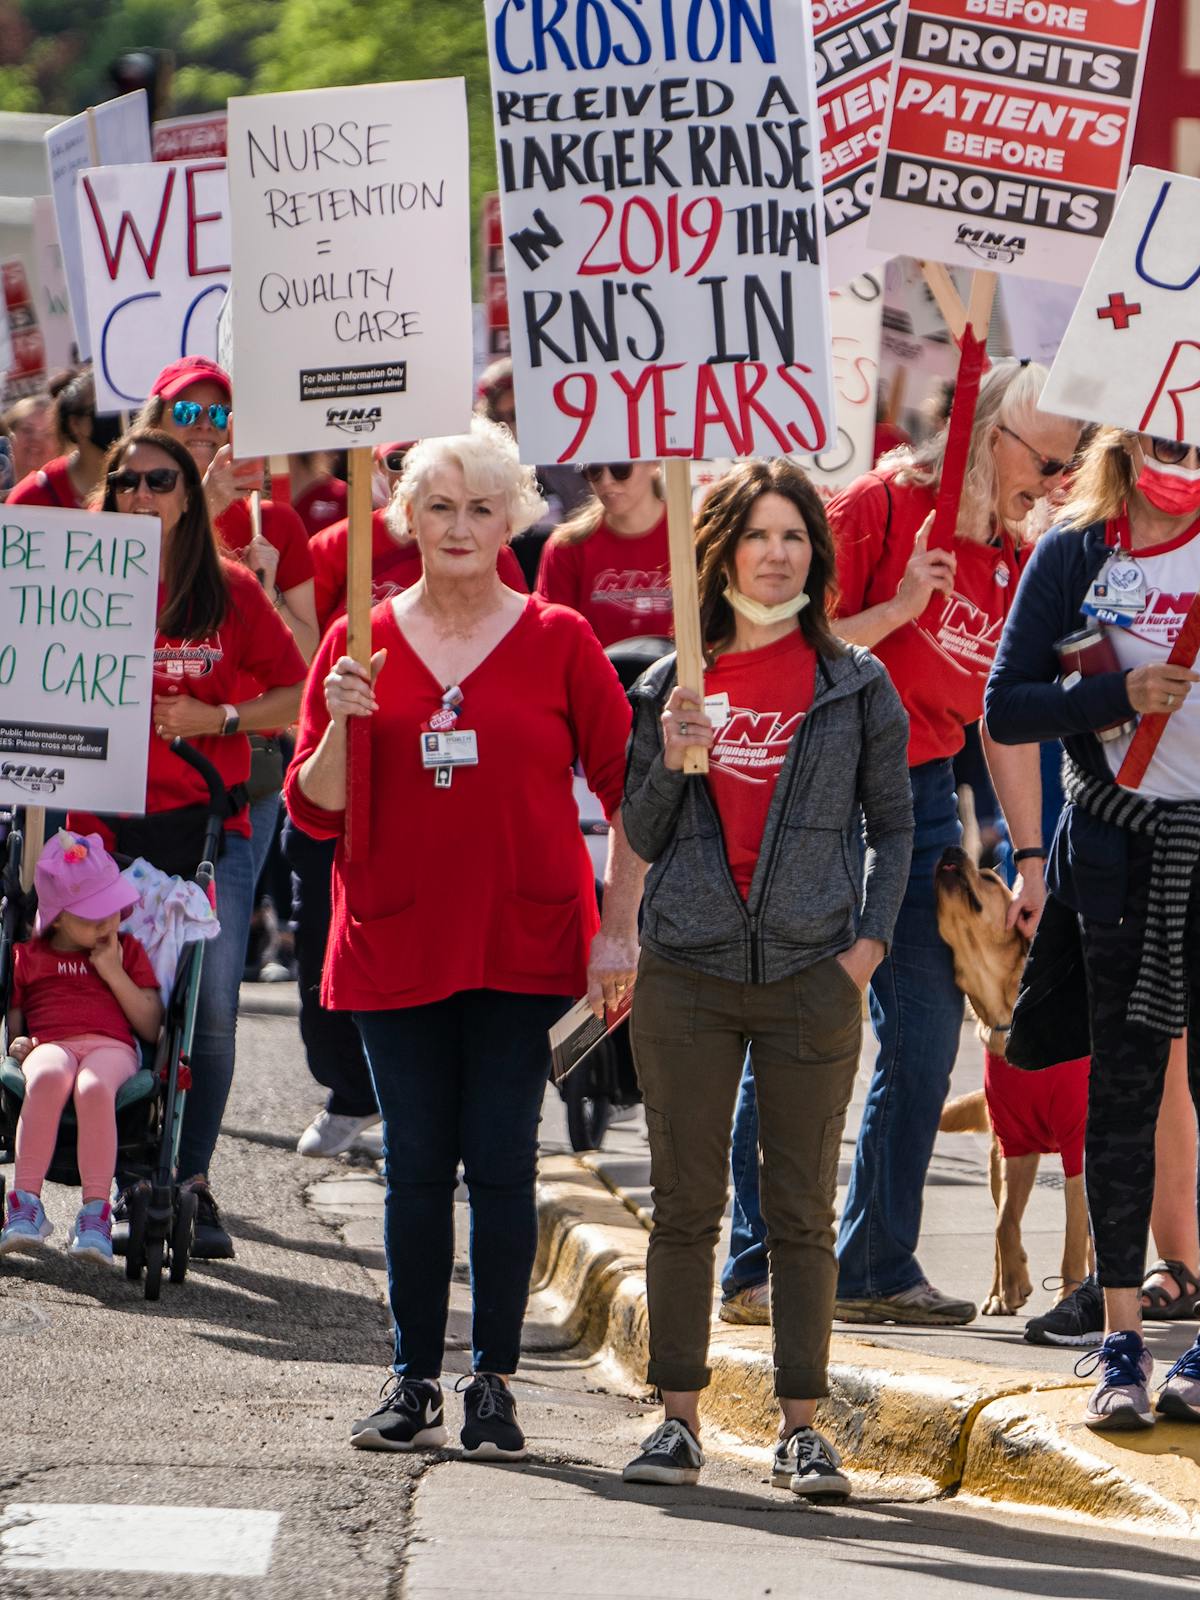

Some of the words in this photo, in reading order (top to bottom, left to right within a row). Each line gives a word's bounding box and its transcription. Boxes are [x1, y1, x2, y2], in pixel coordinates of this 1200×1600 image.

[494, 0, 776, 74] CROSTON
[966, 0, 1088, 31] BEFORE
[916, 22, 1122, 90] PROFITS
[497, 77, 735, 126] RECEIVED
[756, 75, 799, 119] A
[896, 78, 1126, 146] PATIENTS
[247, 121, 393, 179] NURSE
[500, 127, 682, 193] LARGER
[687, 118, 816, 193] RAISE
[944, 130, 1066, 173] BEFORE
[263, 179, 446, 230] RETENTION
[896, 162, 1100, 231] PROFITS
[82, 161, 231, 281] WE
[508, 208, 564, 272] IN
[576, 193, 722, 277] 2019
[725, 198, 819, 265] THAN
[957, 226, 1027, 250] MNA
[259, 267, 394, 313] QUALITY
[334, 309, 424, 344] CARE
[523, 279, 666, 368] RN'S
[698, 270, 795, 368] IN
[303, 374, 316, 385] For
[317, 372, 341, 383] Public
[342, 368, 385, 380] Information
[387, 366, 404, 378] Only
[326, 406, 382, 422] MNA
[552, 371, 598, 463] 9
[611, 361, 827, 460] YEARS
[1, 524, 46, 570] BE
[65, 529, 149, 579] FAIR
[10, 584, 134, 629] THOSE
[1096, 609, 1118, 623] RN
[1147, 615, 1182, 625] Nurses
[42, 642, 147, 707] CARE
[0, 727, 23, 737] Public
[25, 730, 68, 741] Information
[69, 734, 85, 742] only
[16, 740, 40, 748] Please
[41, 742, 61, 750] cross
[62, 743, 76, 751] and
[77, 743, 103, 752] deliver
[712, 744, 769, 758] Minnesota
[1, 764, 65, 781] MNA
[57, 960, 88, 976] MNA
